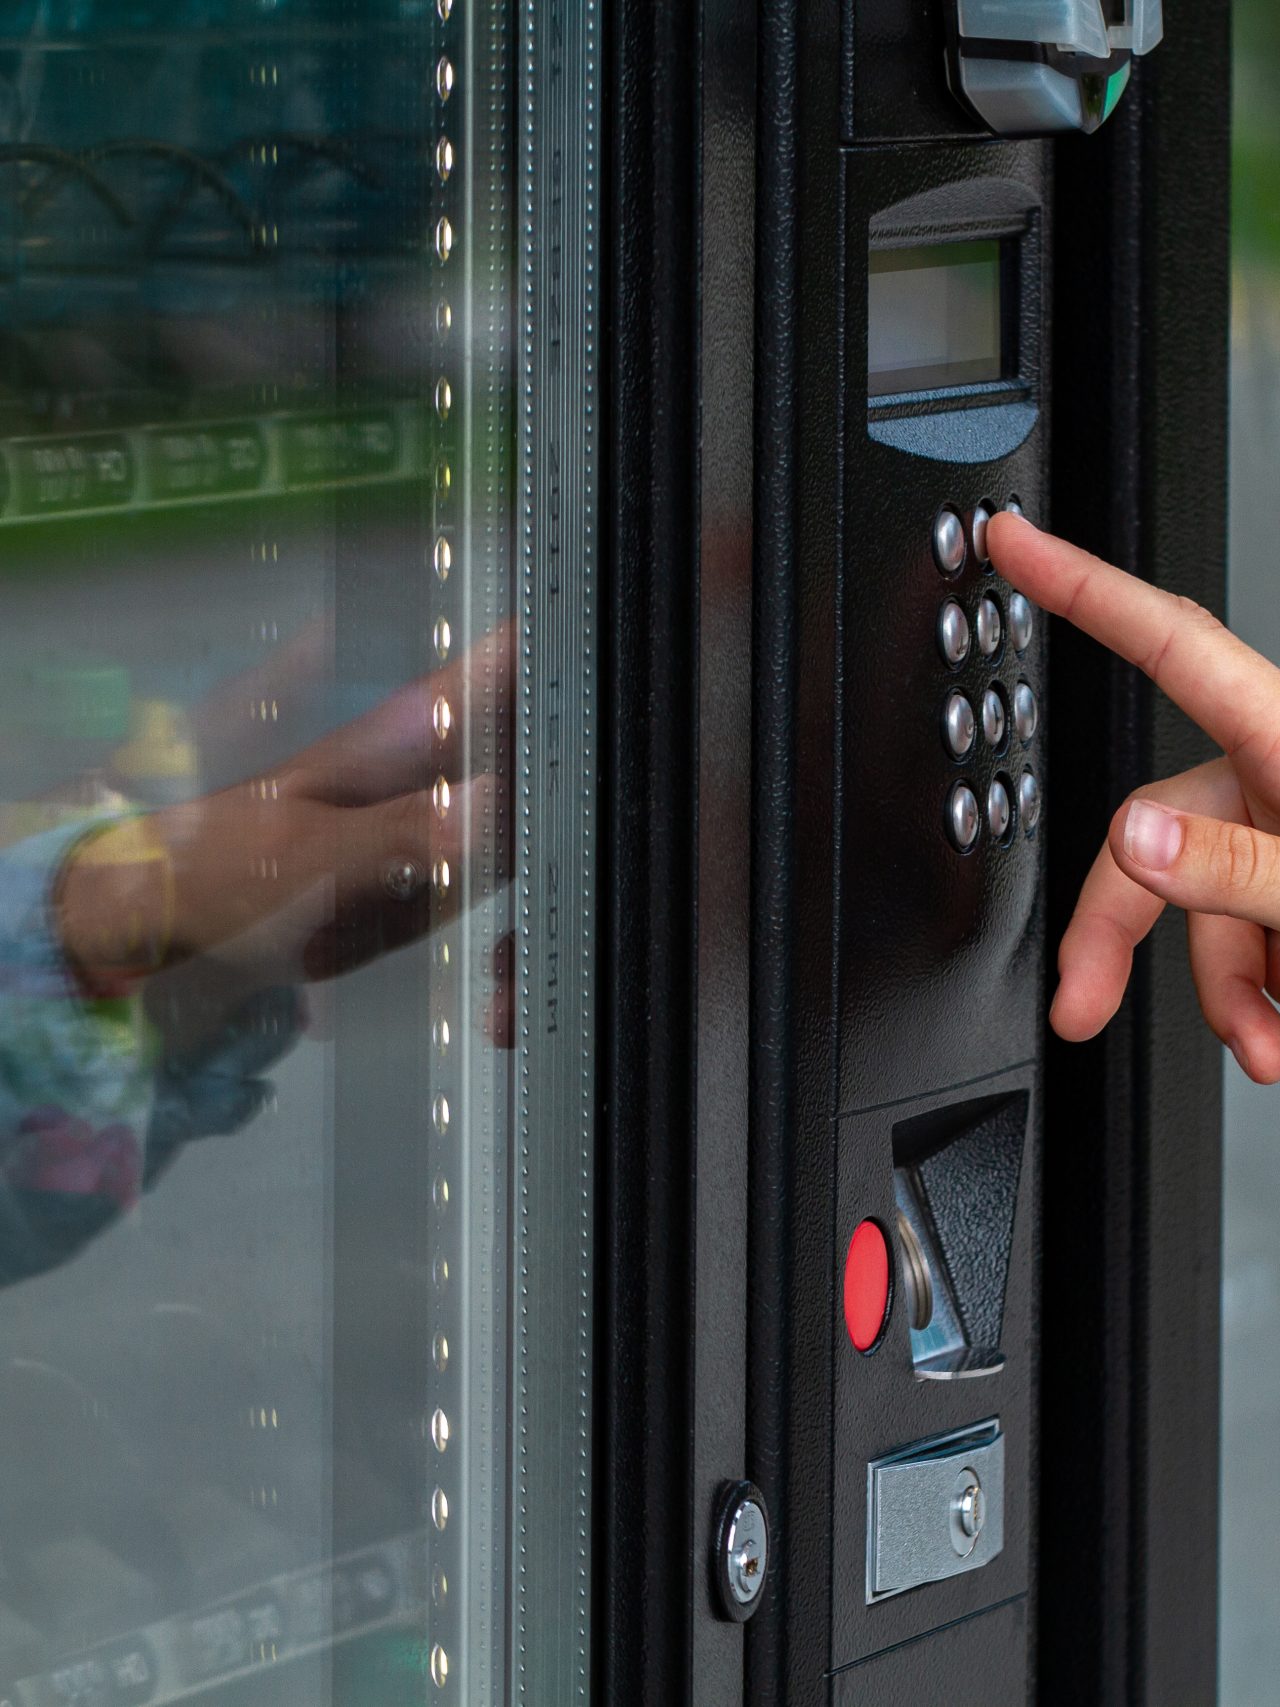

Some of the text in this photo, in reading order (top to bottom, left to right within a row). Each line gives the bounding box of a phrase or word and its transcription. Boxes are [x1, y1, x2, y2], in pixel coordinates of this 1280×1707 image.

[550, 440, 560, 604] 2011
[549, 669, 559, 797] TEK
[547, 860, 558, 1034] 20MM
